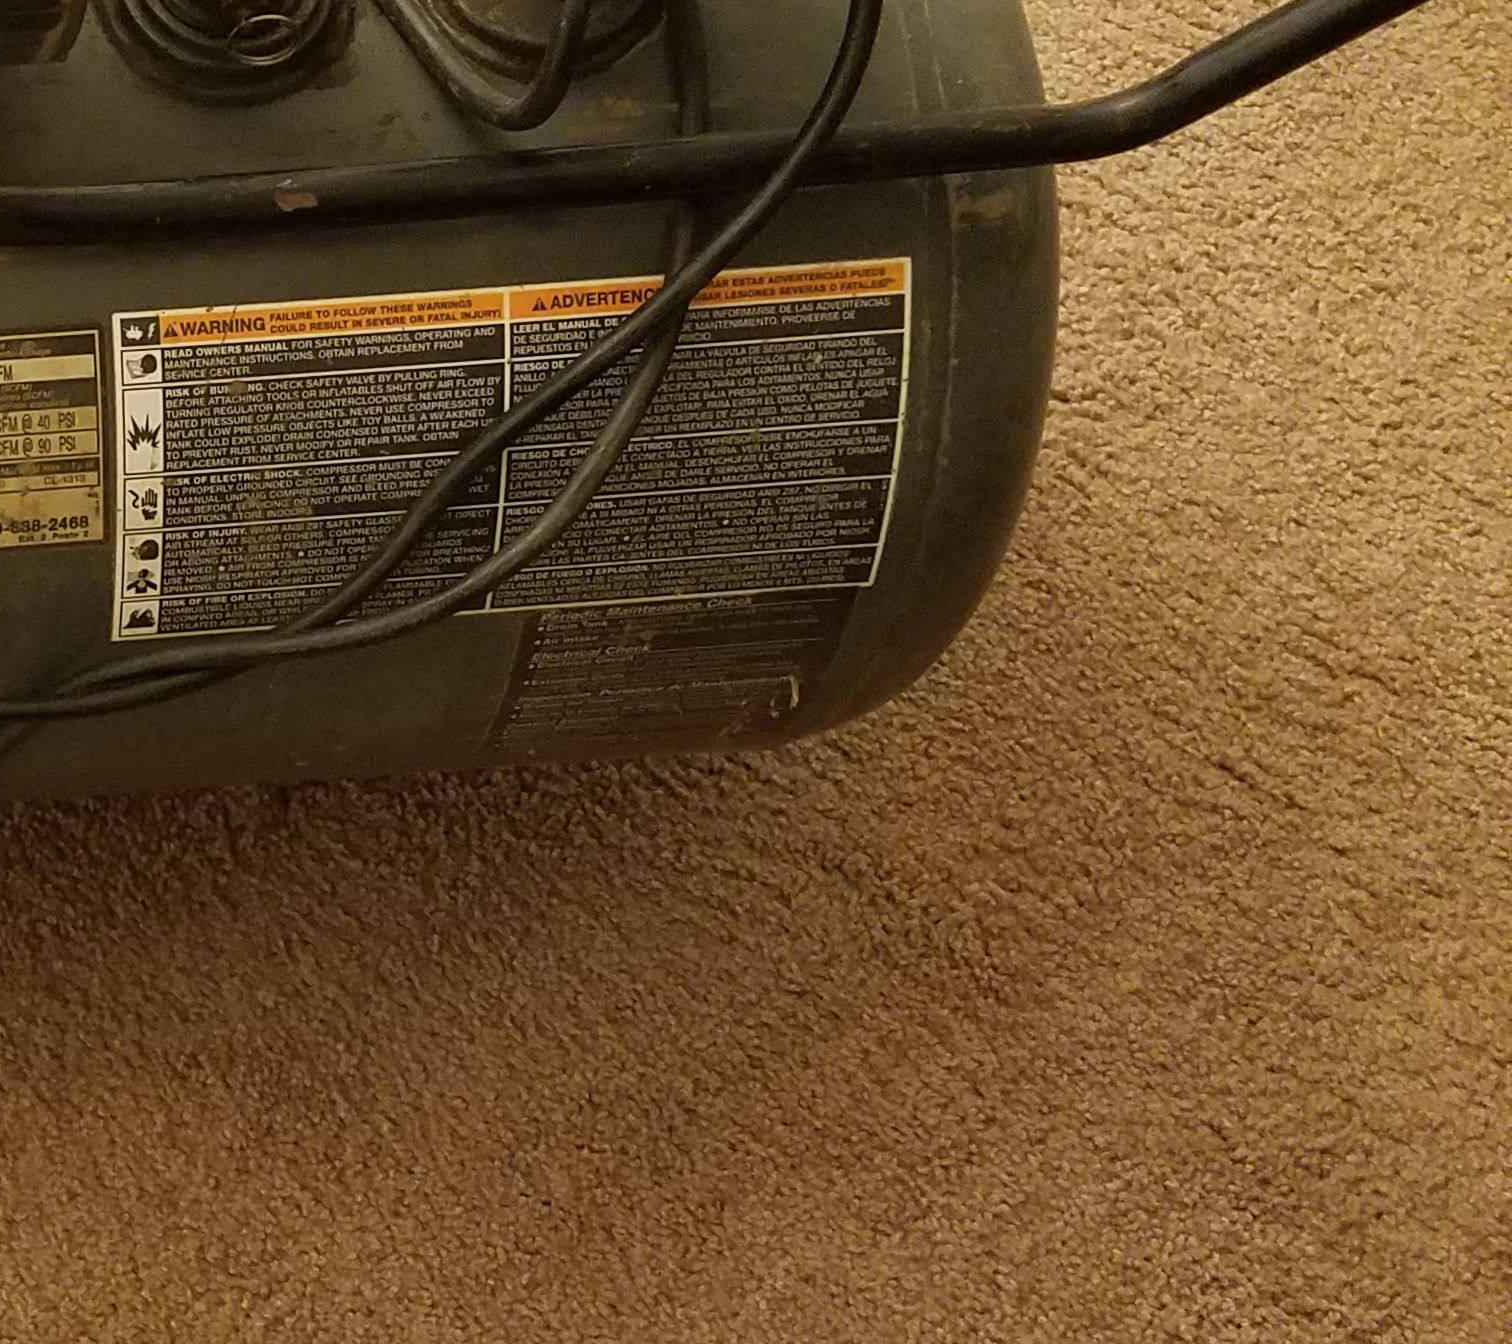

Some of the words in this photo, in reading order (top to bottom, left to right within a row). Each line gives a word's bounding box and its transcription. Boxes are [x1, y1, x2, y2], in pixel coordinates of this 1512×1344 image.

[732, 276, 764, 286] ESTAS
[550, 287, 662, 309] ADVERTENC
[713, 305, 775, 318] INFORMARSE
[779, 304, 792, 314] DE
[795, 302, 813, 313] LAS
[816, 297, 891, 311] ADVERTENCIAS
[270, 310, 312, 321] FAILURE
[316, 309, 329, 318] TO
[333, 306, 376, 317] FOLLOW
[380, 304, 413, 314] THESE
[417, 300, 472, 311] WARNINGS
[180, 316, 266, 336] WARNING
[270, 322, 305, 333] COULD
[310, 319, 349, 330] RESULT
[352, 319, 361, 327] IN
[366, 316, 404, 326] SEVERE
[409, 315, 423, 324] OR
[427, 312, 456, 322] FATAL
[513, 323, 539, 333] LEER
[542, 322, 555, 331] EL
[558, 319, 601, 330] MANUAL
[604, 318, 618, 327] DE
[164, 348, 192, 358] READ
[195, 344, 241, 356] OWNERS
[244, 341, 288, 353] MANUAL
[291, 340, 312, 350] FOR
[315, 337, 351, 348] SAFETY
[414, 329, 471, 341] OPERATING
[473, 327, 495, 337] AND
[513, 334, 526, 344] DE
[529, 330, 586, 343] SEGURIDAD
[588, 330, 595, 339] E
[513, 342, 572, 354] REPUESTOS
[574, 341, 587, 350] EN
[164, 355, 237, 369] MAINTENANCE
[318, 347, 354, 358] OBTAIN
[357, 342, 431, 356] REPLACEMENT
[433, 340, 463, 351] FROM
[165, 368, 206, 380] SERVICE
[209, 365, 252, 377] CENTER.
[513, 361, 549, 372] RIESGO
[551, 360, 565, 369] DE
[165, 387, 189, 397] RISK
[192, 386, 205, 396] OF
[268, 379, 303, 391] CHECK
[306, 377, 342, 388] SAFETY
[345, 374, 375, 385] VALVE
[378, 373, 390, 383] BY
[394, 370, 437, 382] PULLING
[165, 396, 205, 408] BEFORE
[208, 392, 263, 405] ATTACHING
[266, 390, 299, 401] TOOLS
[301, 389, 316, 399] OR
[386, 382, 412, 393] SHUT
[415, 381, 434, 391] OFF
[437, 380, 453, 390] AIR
[456, 378, 485, 388] FLOW
[487, 377, 501, 386] BY
[166, 407, 210, 418] TURNING
[213, 403, 272, 415] REGULATOR
[275, 401, 304, 411] KNOB
[419, 391, 452, 401] NEVER
[455, 388, 494, 399] EXCEED
[166, 418, 198, 429] RATED
[200, 414, 253, 426] PRESSURE
[256, 413, 269, 423] OF
[349, 406, 382, 416] NEVER
[385, 404, 405, 414] USE
[407, 399, 478, 412] COMPRESSOR
[481, 398, 494, 408] TO
[22, 413, 32, 433] @
[37, 414, 50, 430] 40
[58, 411, 75, 429] PSI
[166, 428, 204, 439] INFLATE
[208, 426, 231, 436] LOW
[234, 422, 286, 435] PRESSURE
[289, 419, 334, 431] OBJECTS
[337, 418, 358, 428] LIKE
[361, 416, 381, 426] TOY
[419, 413, 427, 422] A
[429, 409, 485, 422] WEAKENED
[165, 450, 179, 459] TO
[182, 447, 227, 458] PREVENT
[260, 442, 293, 453] NEVER
[296, 440, 333, 451] MODIFY
[337, 439, 351, 448] OR
[354, 436, 389, 447] REPAIR
[422, 431, 459, 442] OBTAIN
[166, 439, 191, 449] TANK
[194, 437, 229, 447] COULD
[283, 431, 313, 441] DRAIN
[316, 427, 378, 439] CONDENSED
[381, 424, 414, 435] WATER
[417, 422, 449, 433] AFTER
[451, 420, 478, 430] EACH
[23, 437, 32, 457] @
[38, 437, 51, 454] 90
[59, 434, 75, 452] PSI
[166, 456, 239, 470] REPLACEMENT
[242, 454, 271, 465] FROM
[274, 451, 314, 463] SERVICE
[318, 448, 360, 460] CENTER.
[210, 471, 261, 483] ELECTRIC
[306, 463, 375, 477] COMPRESSOR
[506, 506, 544, 515] RIESGO
[165, 531, 189, 540] RISK
[192, 530, 205, 539] OF
